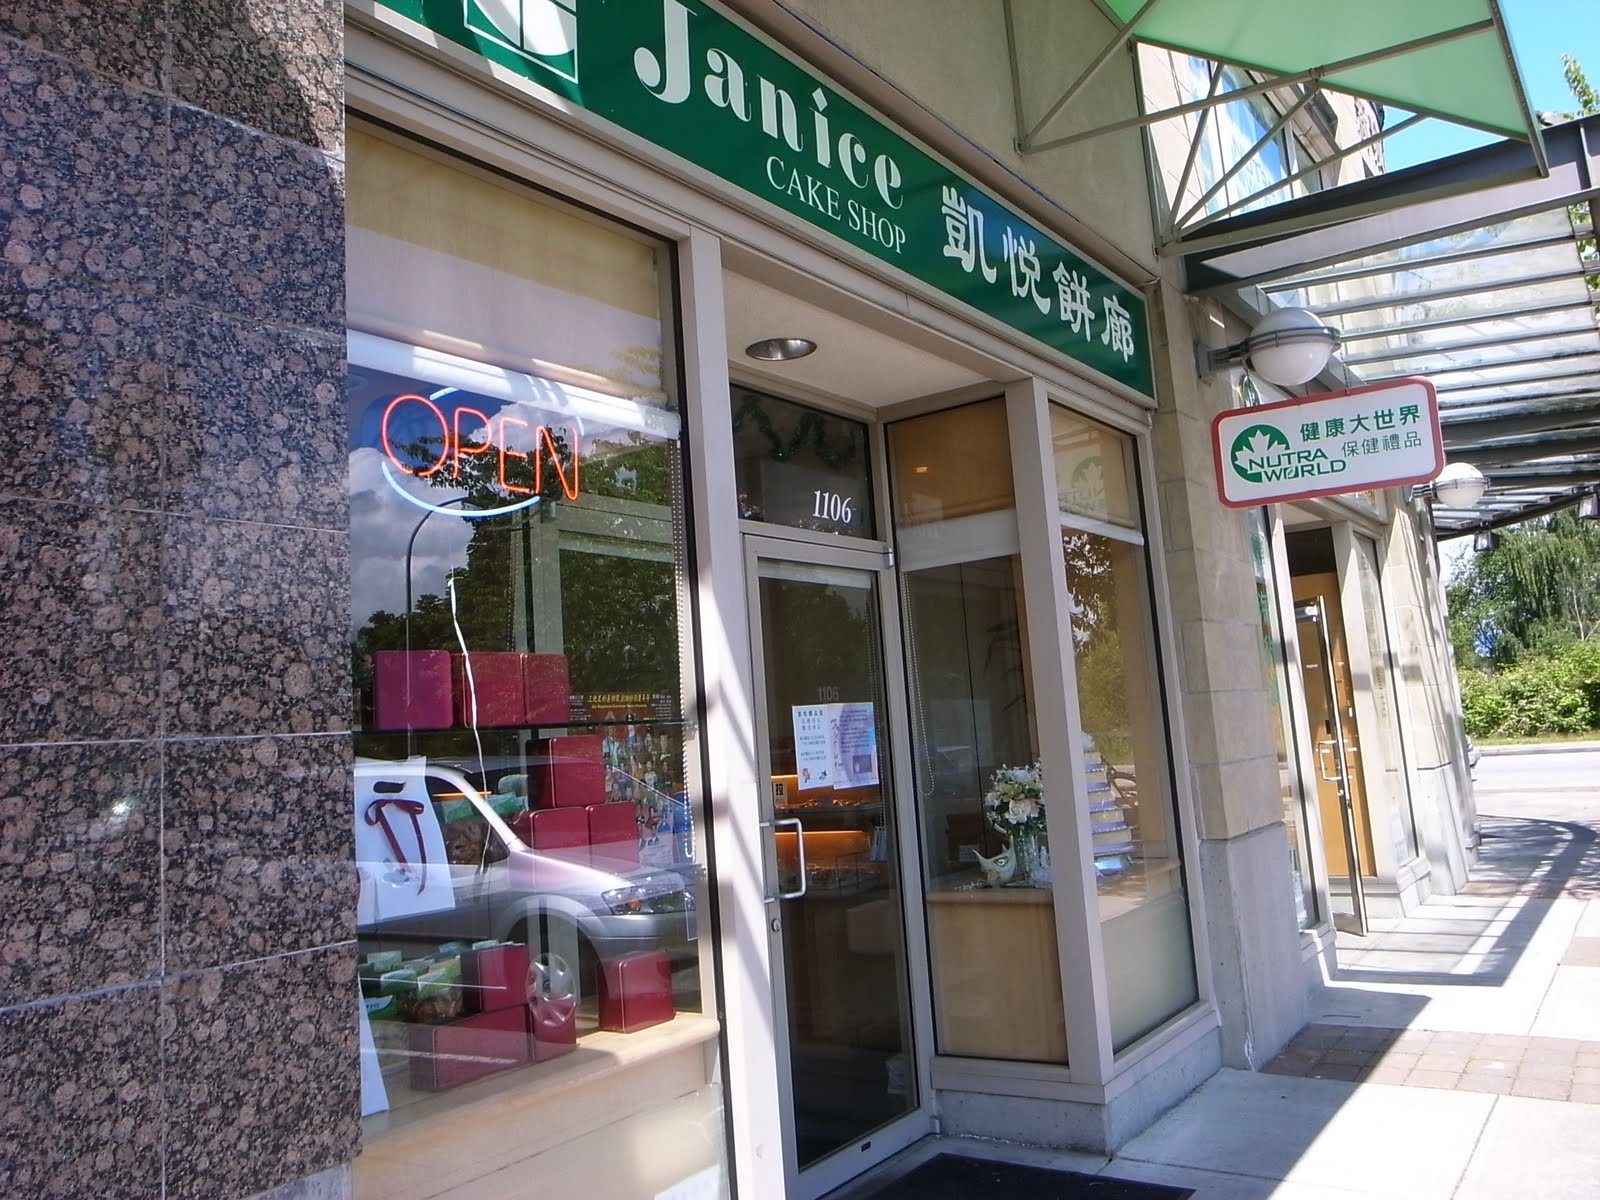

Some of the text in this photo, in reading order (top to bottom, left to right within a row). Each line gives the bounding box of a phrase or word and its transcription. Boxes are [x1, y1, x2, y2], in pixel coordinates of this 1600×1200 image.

[633, 0, 904, 210] Janice
[766, 156, 906, 254] CAKE SHOP
[1299, 404, 1421, 442] 健康大世界
[381, 393, 580, 502] OPEN
[1248, 448, 1328, 471] NUTRA
[1341, 430, 1422, 458] 保健禮品
[1262, 459, 1347, 482] WORLD
[812, 490, 852, 524] 1106
